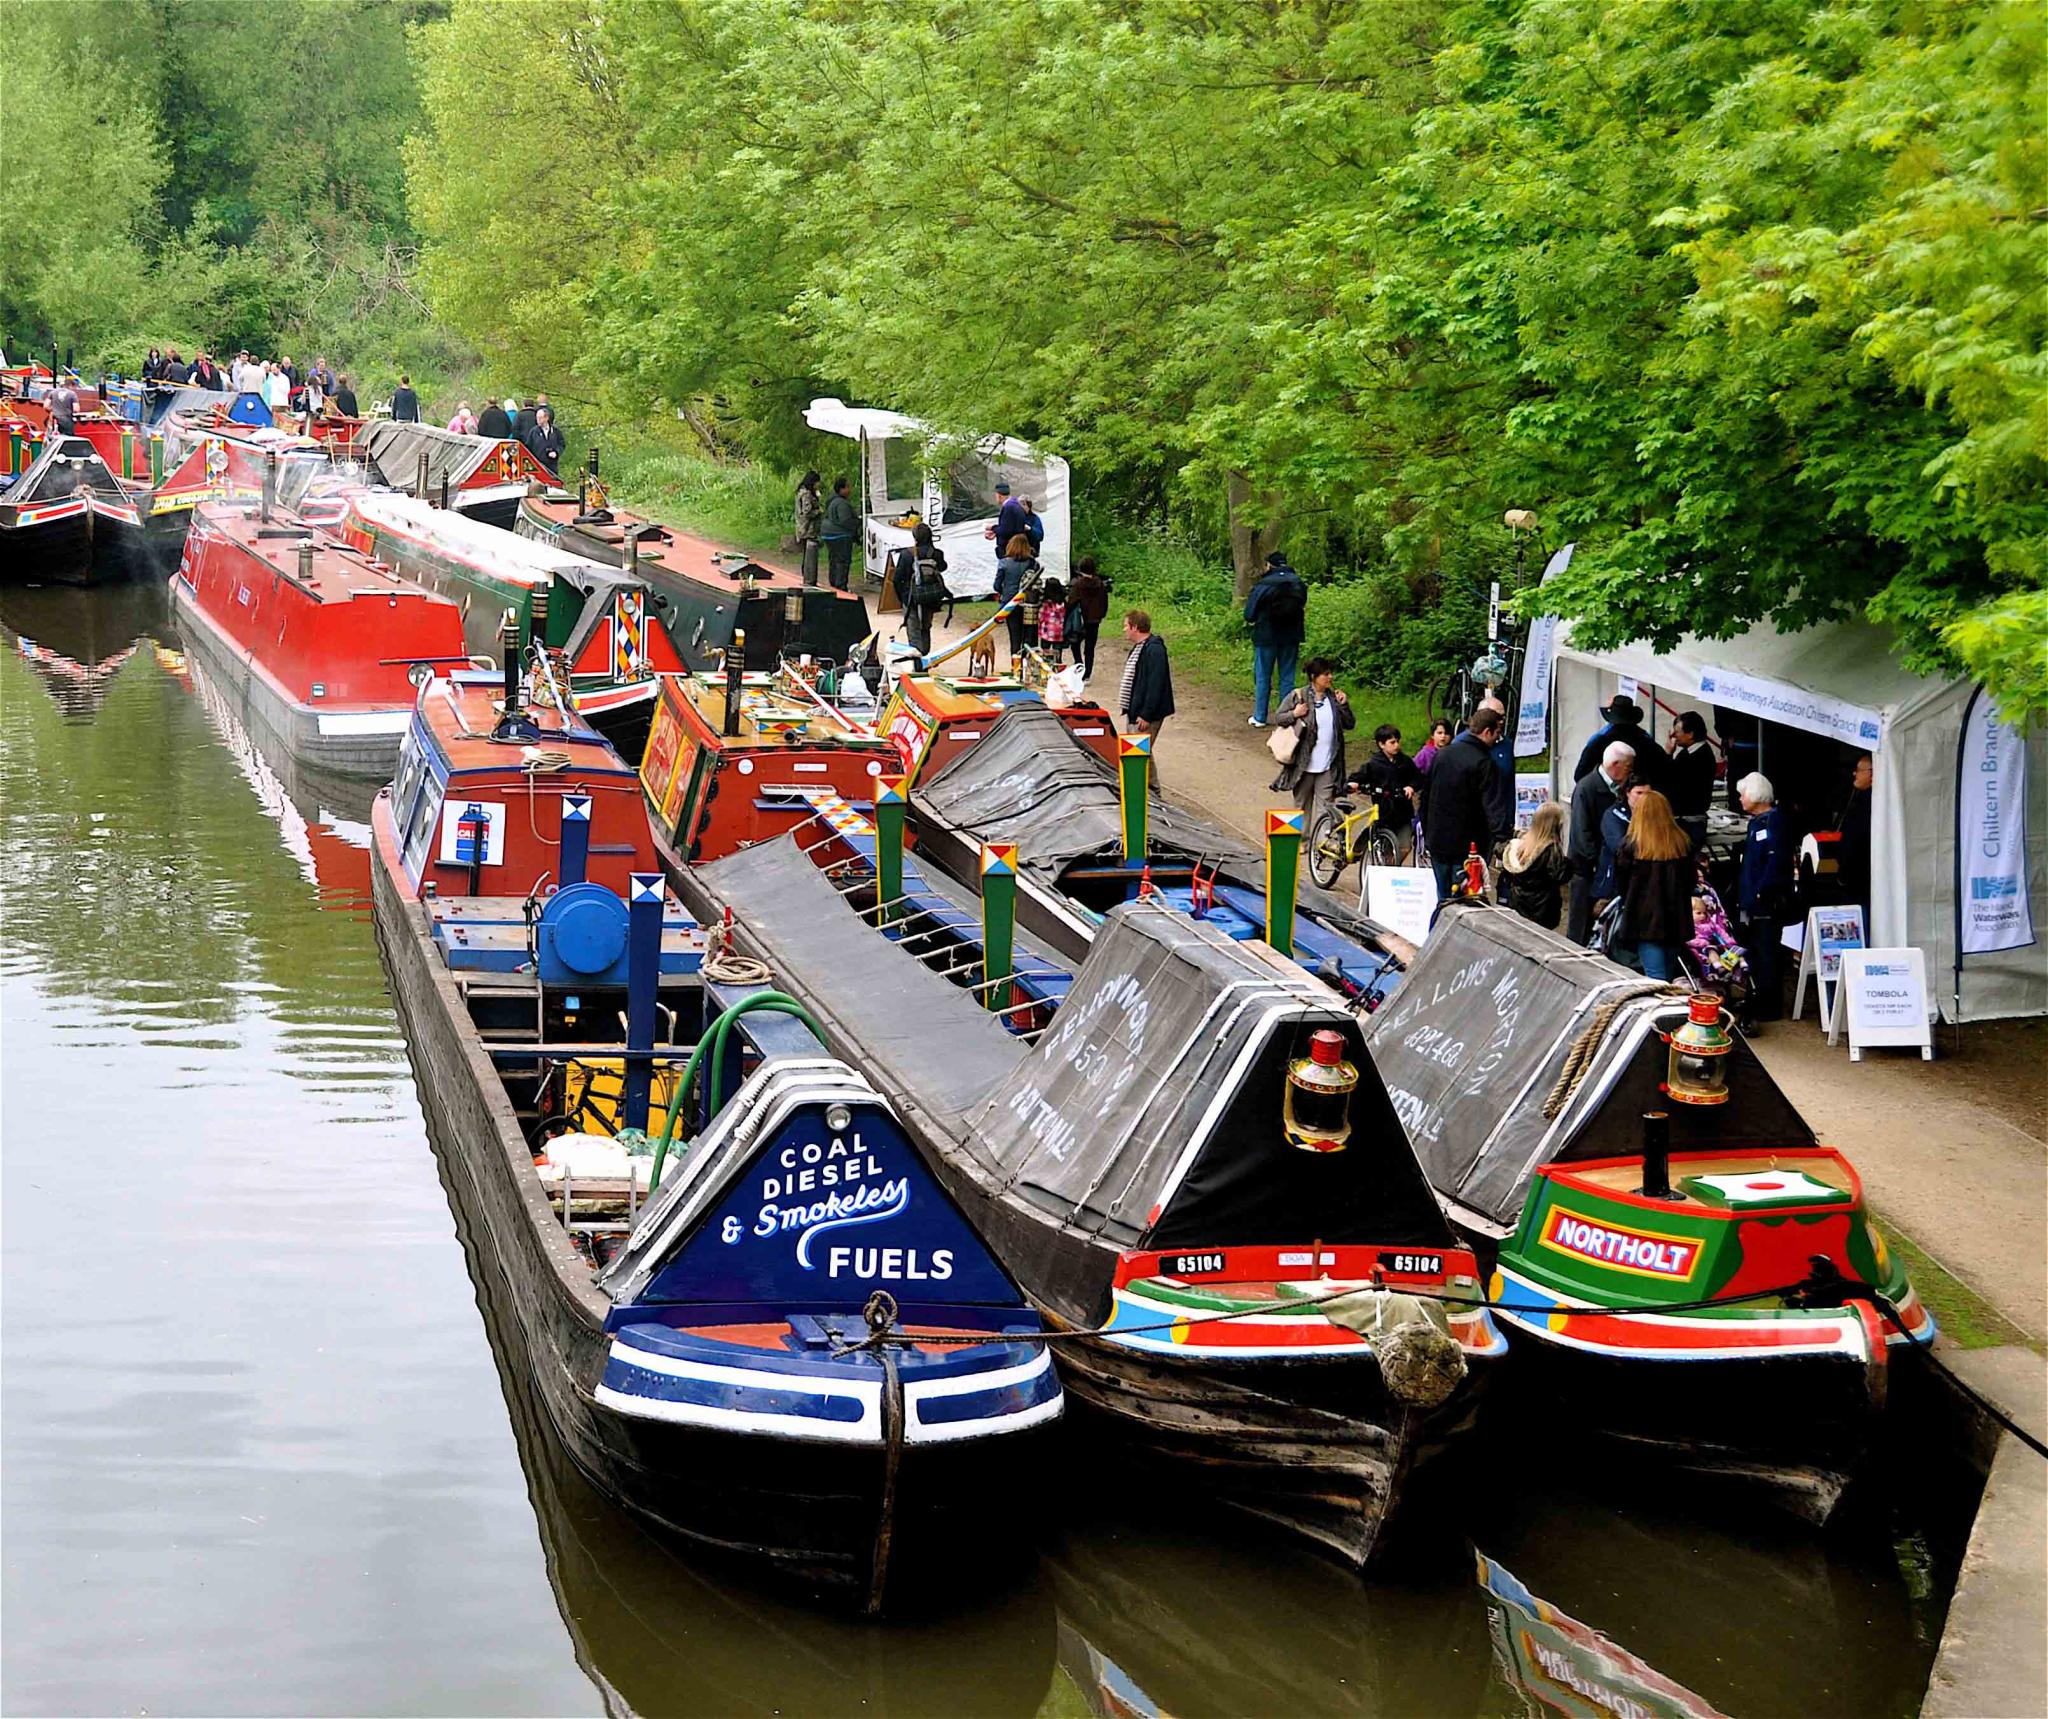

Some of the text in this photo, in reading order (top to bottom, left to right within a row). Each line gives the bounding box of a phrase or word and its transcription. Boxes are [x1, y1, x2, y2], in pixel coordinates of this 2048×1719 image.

[1980, 706, 2000, 859] Chiltern Branch
[1866, 990, 1909, 998] TOMBOLA
[1464, 966, 1520, 1096] MORTON
[780, 1133, 868, 1168] COAL
[763, 1155, 883, 1201] DIESEL
[721, 1176, 911, 1250] & Smokeless
[828, 1246, 954, 1280] FUELS
[1177, 1254, 1222, 1273] 65104
[1394, 1255, 1439, 1273] 65104
[1555, 1216, 1689, 1274] NORTHOLT
